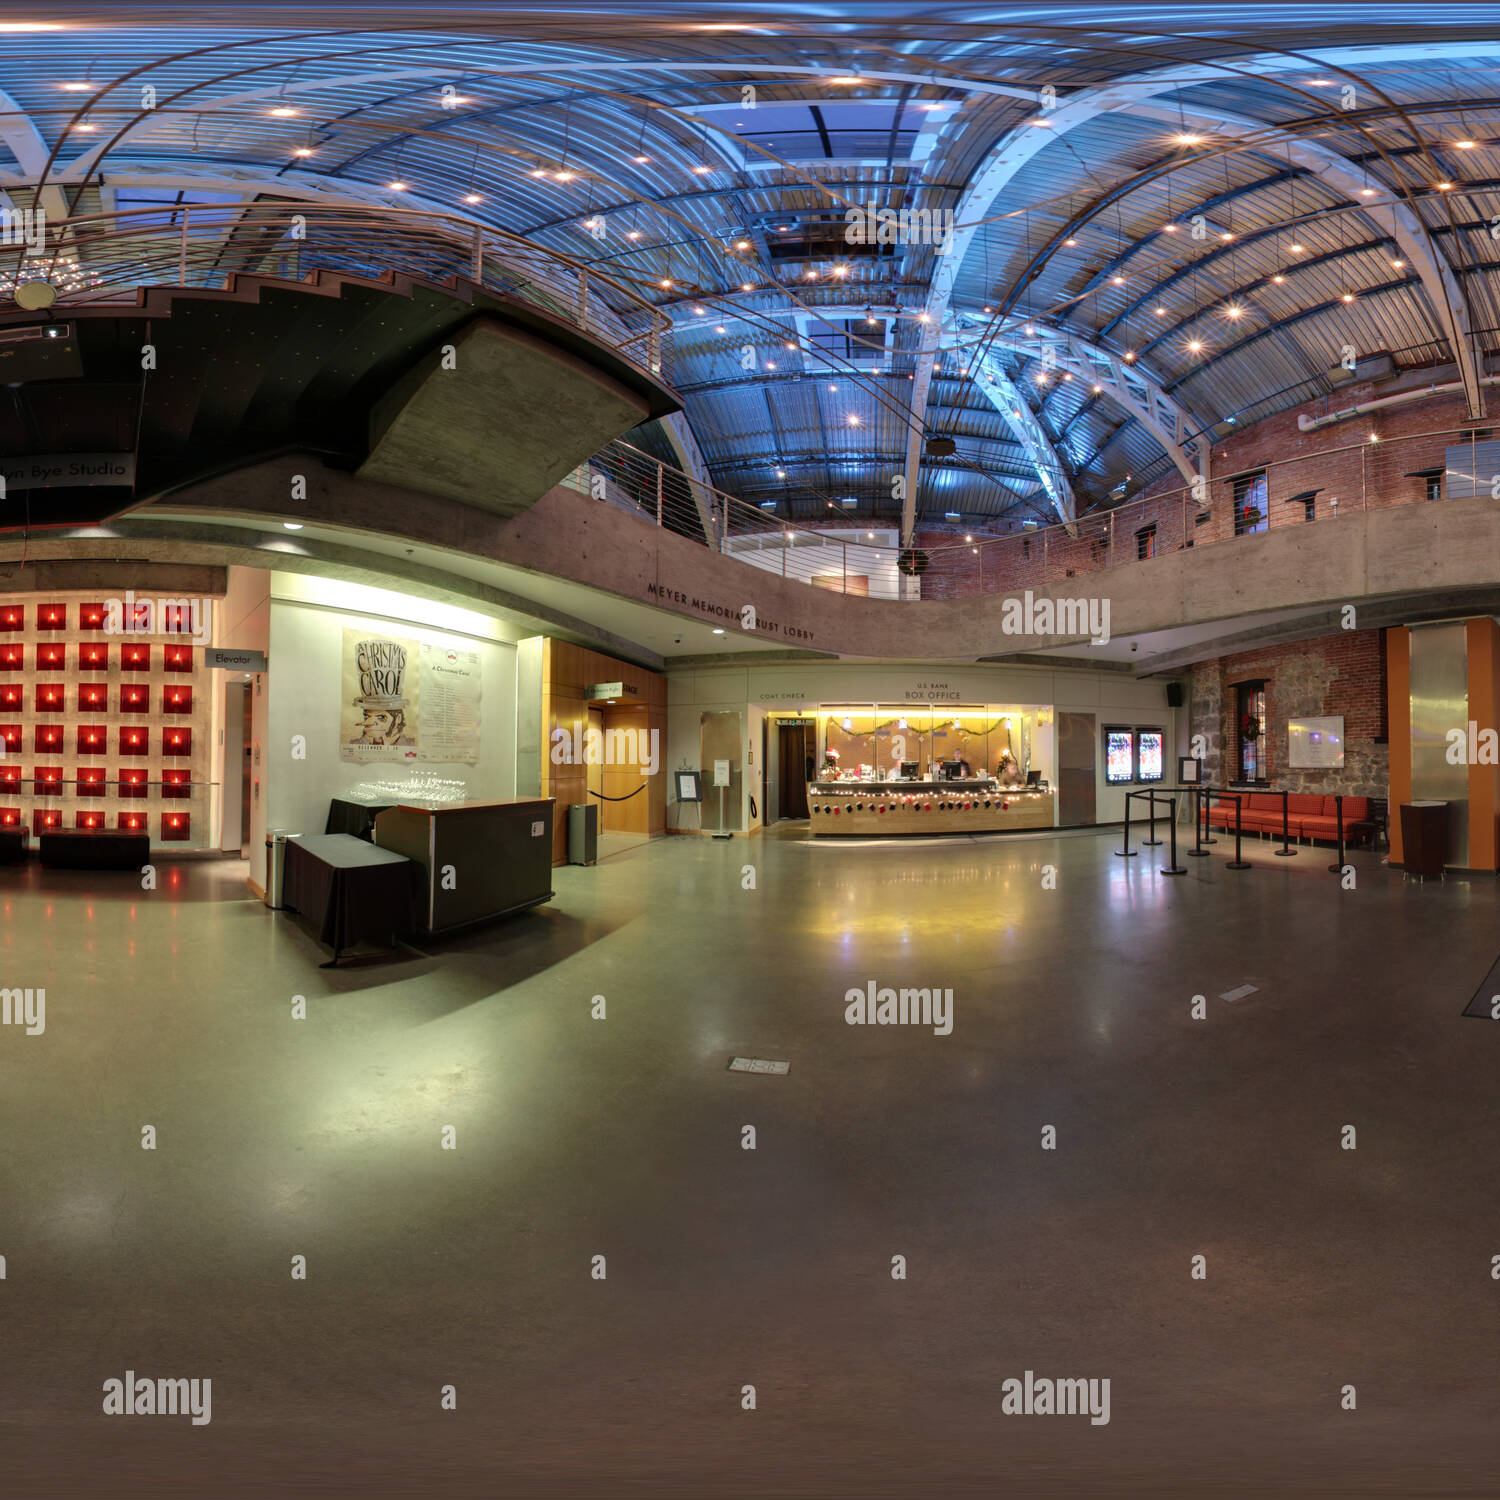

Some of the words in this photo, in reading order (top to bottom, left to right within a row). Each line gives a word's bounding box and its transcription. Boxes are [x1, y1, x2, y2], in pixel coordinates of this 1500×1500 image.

[31, 465, 62, 480] Bye
[69, 461, 126, 476] Studio
[647, 583, 688, 604] MEYER
[749, 614, 779, 633] RUST
[784, 626, 814, 641] LOBBY
[215, 653, 251, 664] Elevator
[361, 670, 401, 696] CAROL
[905, 691, 925, 699] BOX
[927, 691, 961, 700] OFFICE
